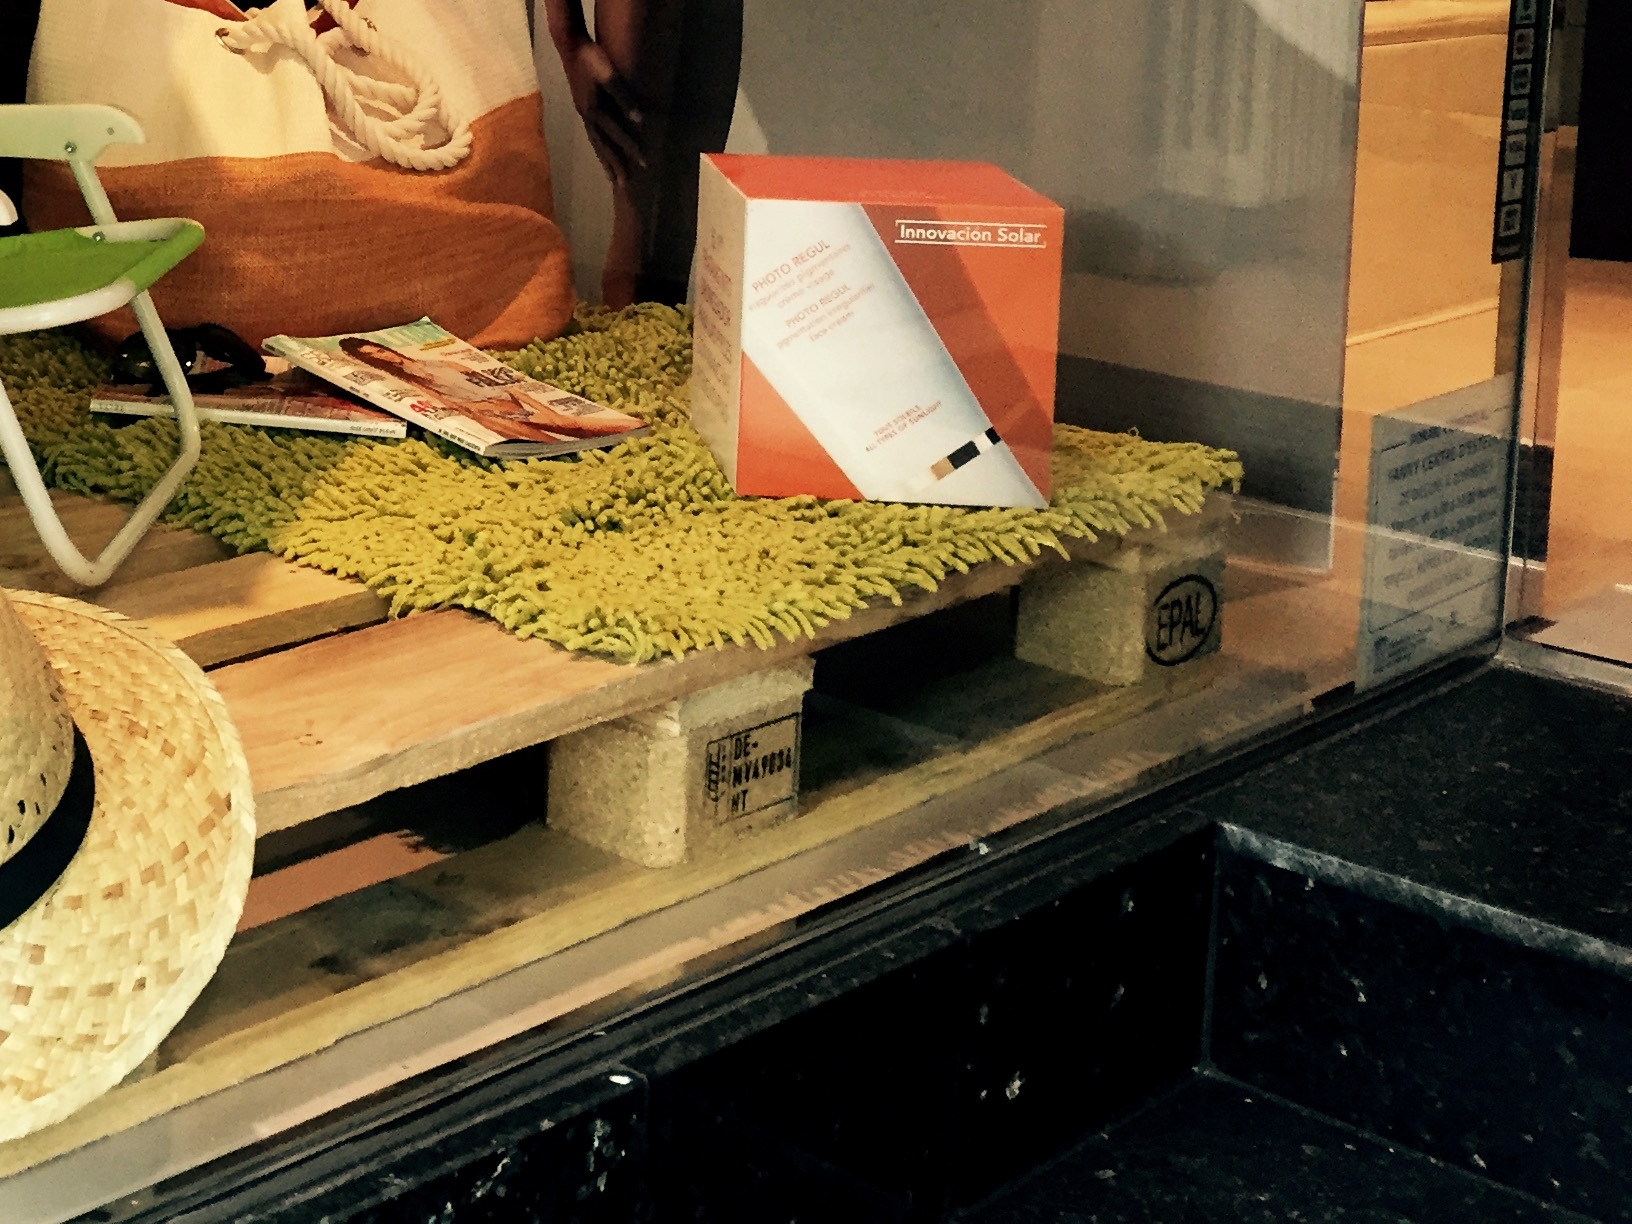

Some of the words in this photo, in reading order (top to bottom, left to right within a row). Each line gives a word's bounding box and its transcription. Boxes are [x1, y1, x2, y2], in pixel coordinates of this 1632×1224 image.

[900, 224, 992, 242] Innovación
[997, 227, 1042, 243] Solar
[751, 262, 791, 292] PHOTO
[791, 239, 831, 267] REGUL
[1156, 591, 1206, 652] EPAL
